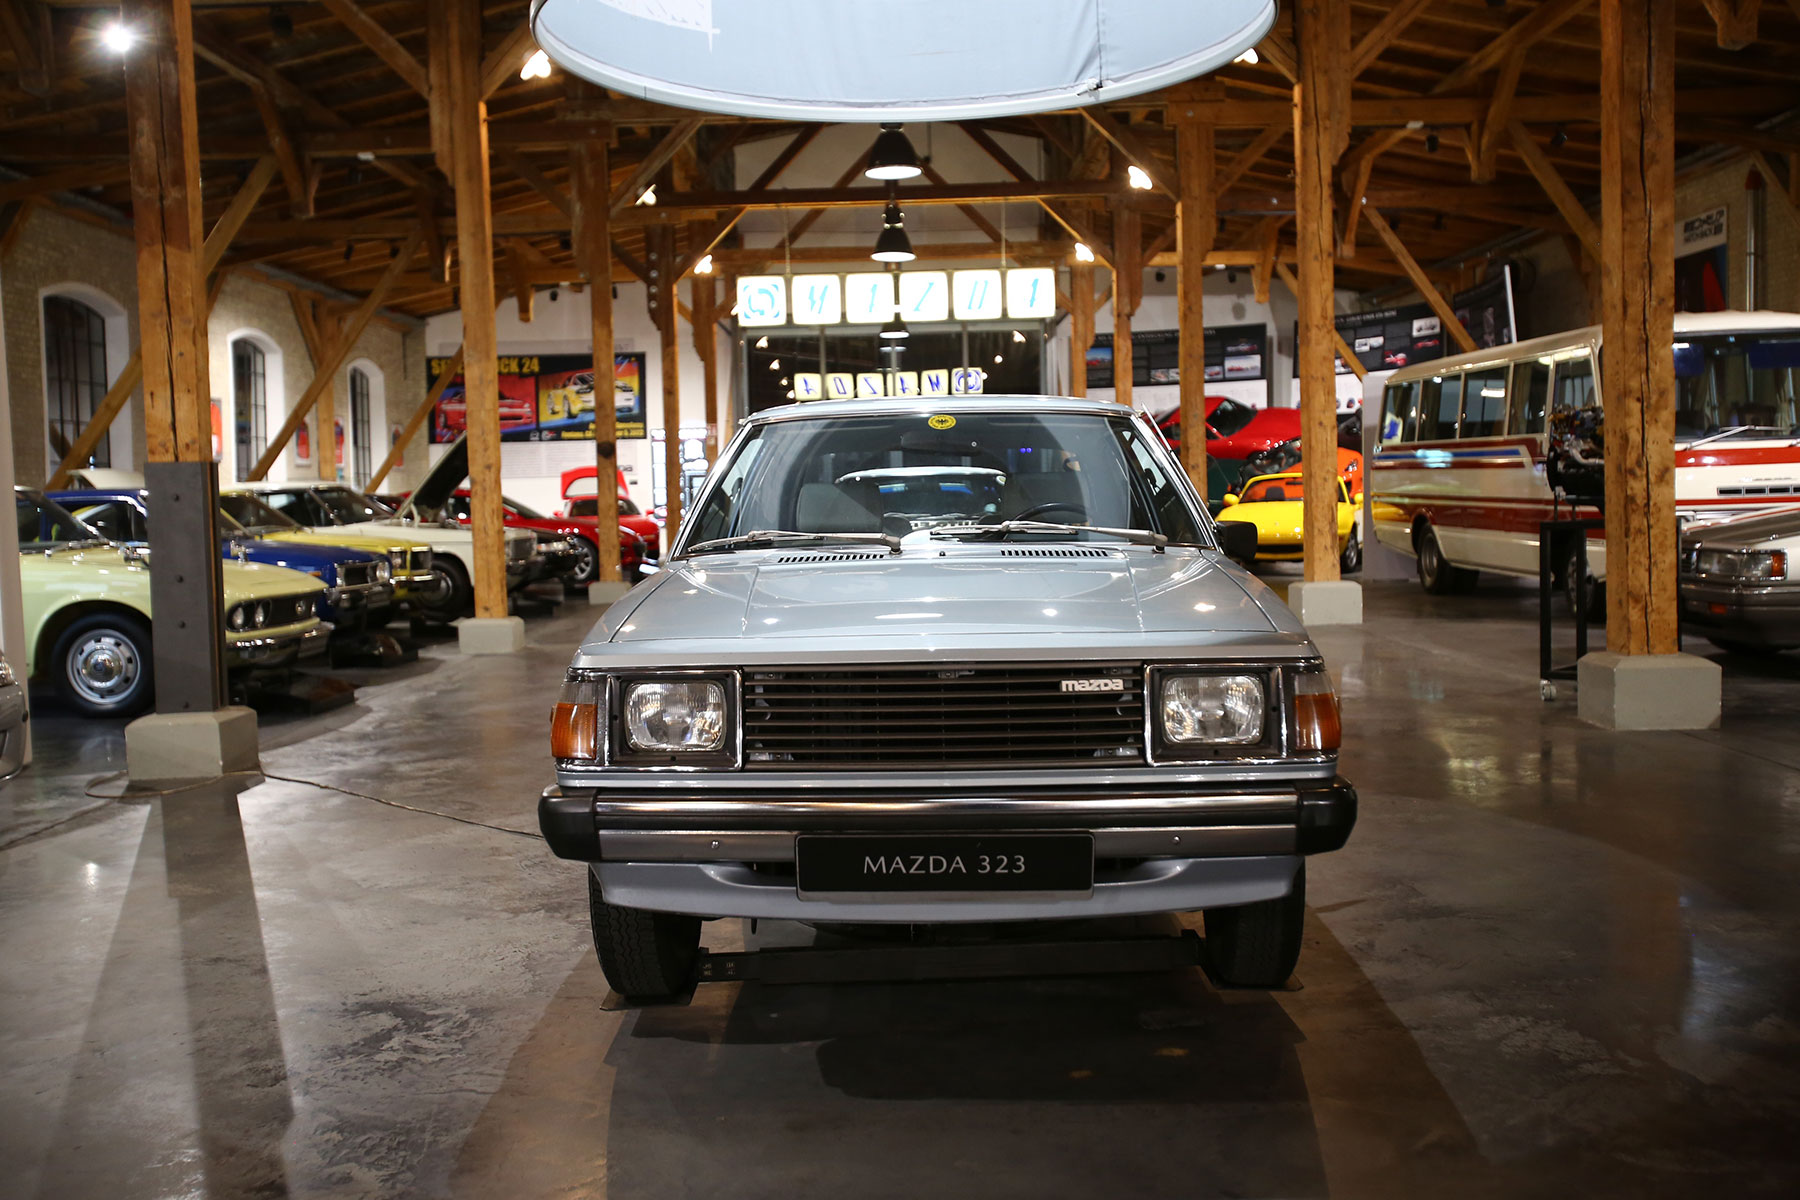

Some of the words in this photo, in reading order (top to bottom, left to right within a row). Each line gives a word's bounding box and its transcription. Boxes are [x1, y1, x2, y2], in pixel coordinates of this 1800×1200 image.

[521, 357, 540, 374] 24
[1061, 679, 1125, 692] mazda
[863, 855, 967, 874] MAZDA
[977, 855, 1026, 874] 323
